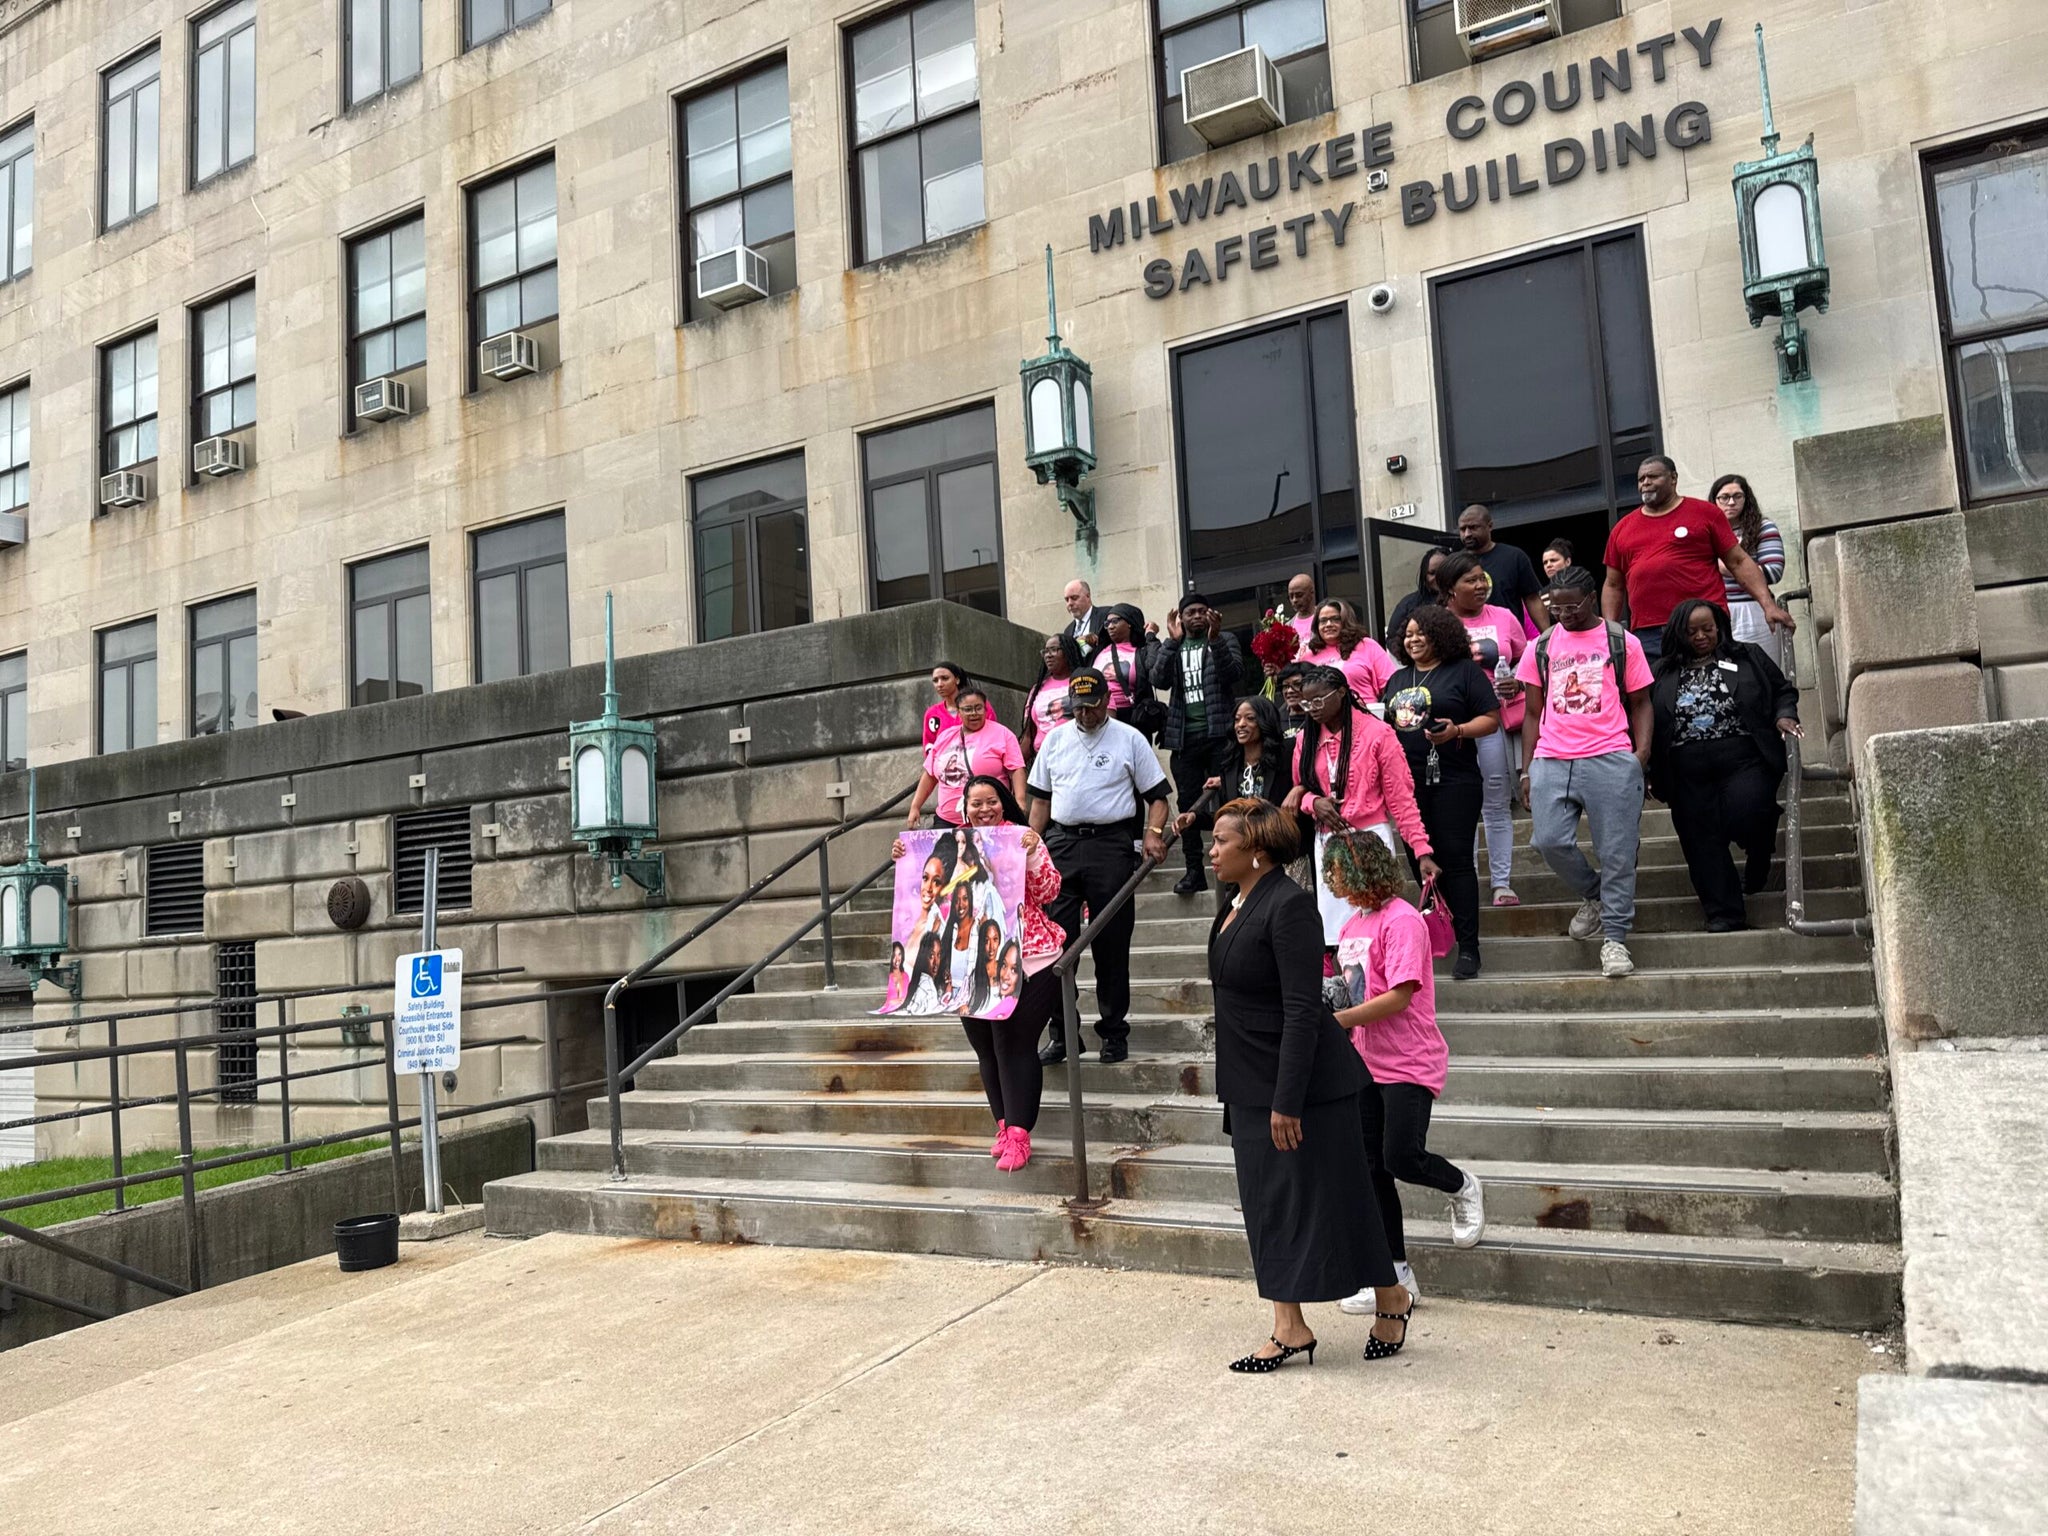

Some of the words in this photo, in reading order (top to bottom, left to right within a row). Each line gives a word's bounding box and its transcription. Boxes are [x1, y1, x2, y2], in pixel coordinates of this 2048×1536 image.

[1089, 121, 1396, 253] MILWAUKEE
[1445, 17, 1724, 140] COUNTY
[1143, 202, 1355, 299] SAFETY
[1400, 100, 1712, 226] BUILDING
[1391, 505, 1412, 517] 821
[407, 1002, 423, 1012] Safety
[423, 1000, 445, 1010] Building
[400, 1012, 426, 1023] Accessible
[426, 1010, 453, 1021] Entrances
[442, 1021, 455, 1031] Side
[397, 1048, 416, 1059] Criminal
[417, 1046, 435, 1057] Justice
[436, 1044, 456, 1056] Facility
